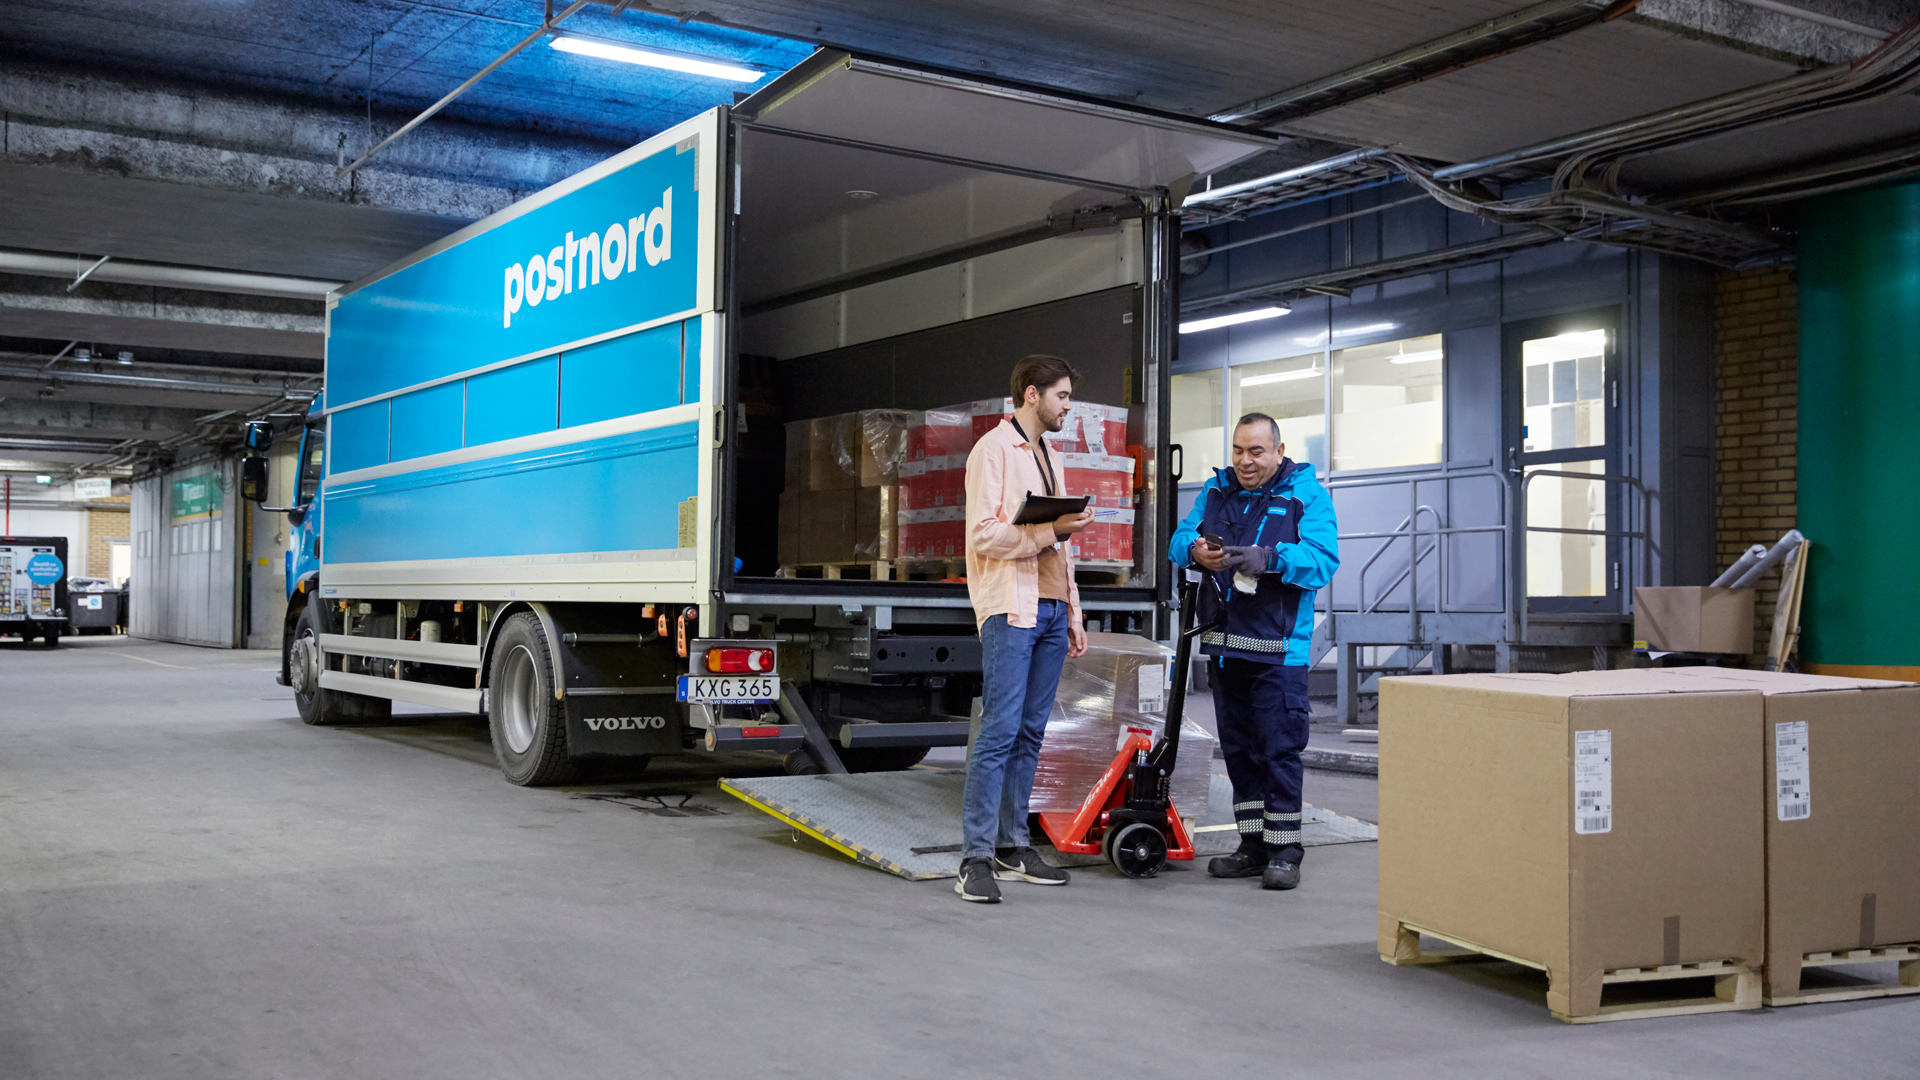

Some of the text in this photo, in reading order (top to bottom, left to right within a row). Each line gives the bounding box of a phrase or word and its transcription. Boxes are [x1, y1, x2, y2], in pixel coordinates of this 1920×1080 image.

[503, 186, 673, 329] postnord
[695, 679, 772, 698] KXG 365
[583, 716, 666, 731] VOLVO
